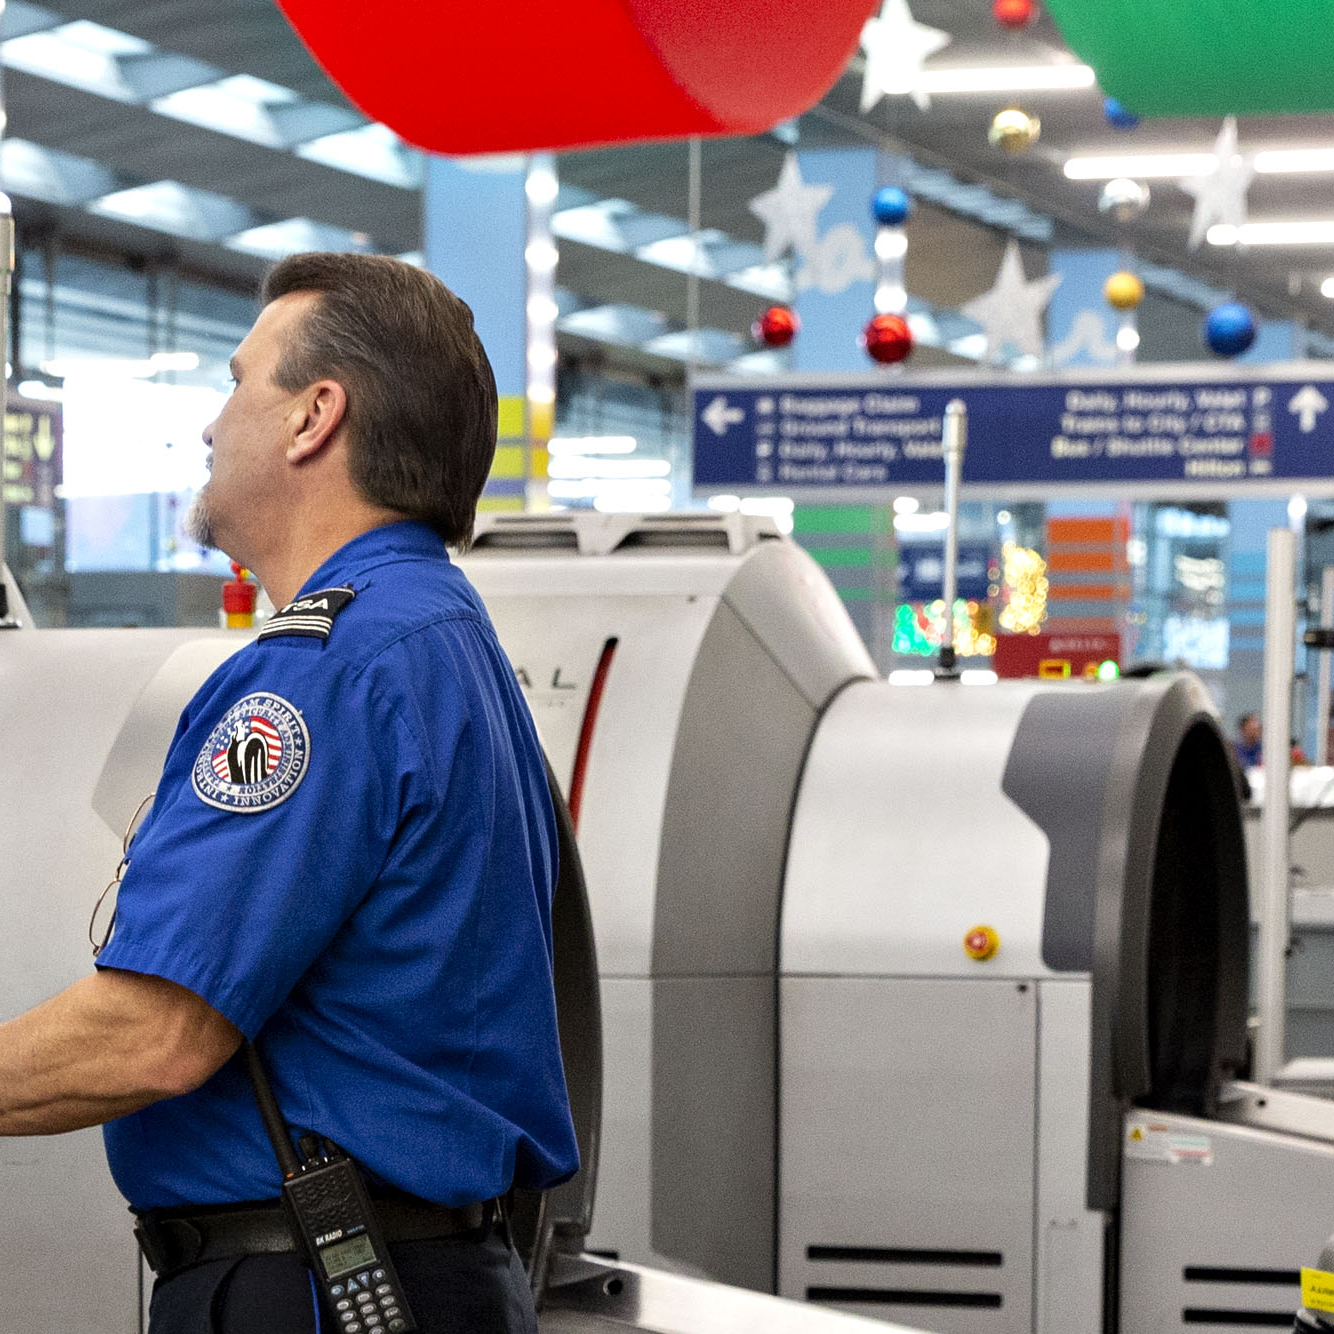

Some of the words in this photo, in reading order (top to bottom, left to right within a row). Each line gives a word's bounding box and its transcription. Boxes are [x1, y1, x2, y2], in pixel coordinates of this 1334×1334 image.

[280, 598, 329, 613] TSA
[263, 699, 301, 735] SPIRIT
[234, 749, 304, 806] INNOVATION
